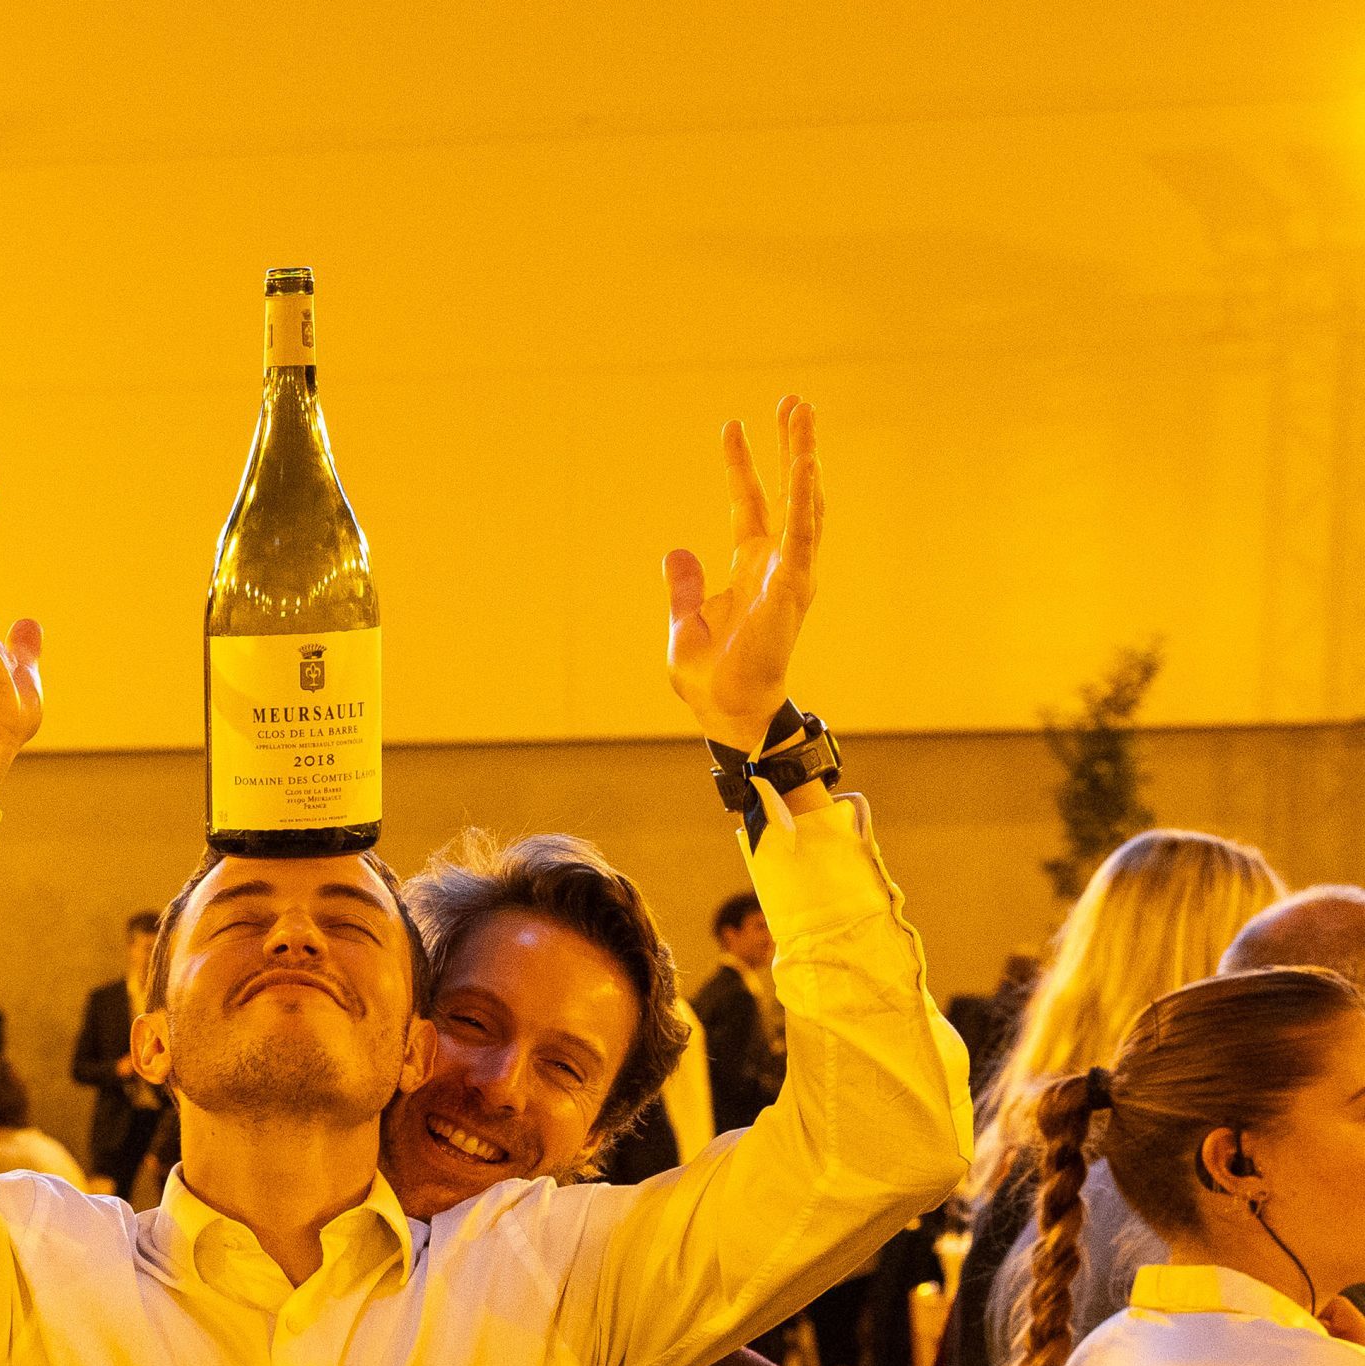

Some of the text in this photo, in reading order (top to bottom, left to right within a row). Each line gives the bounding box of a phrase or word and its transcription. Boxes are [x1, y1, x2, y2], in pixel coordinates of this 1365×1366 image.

[252, 702, 365, 723] MEURSAULT
[257, 725, 358, 739] CLOS DE LA BARRE
[294, 753, 335, 768] 2018
[234, 775, 283, 786] DOMAINE
[288, 776, 308, 785] DES
[312, 773, 353, 784] COMTES
